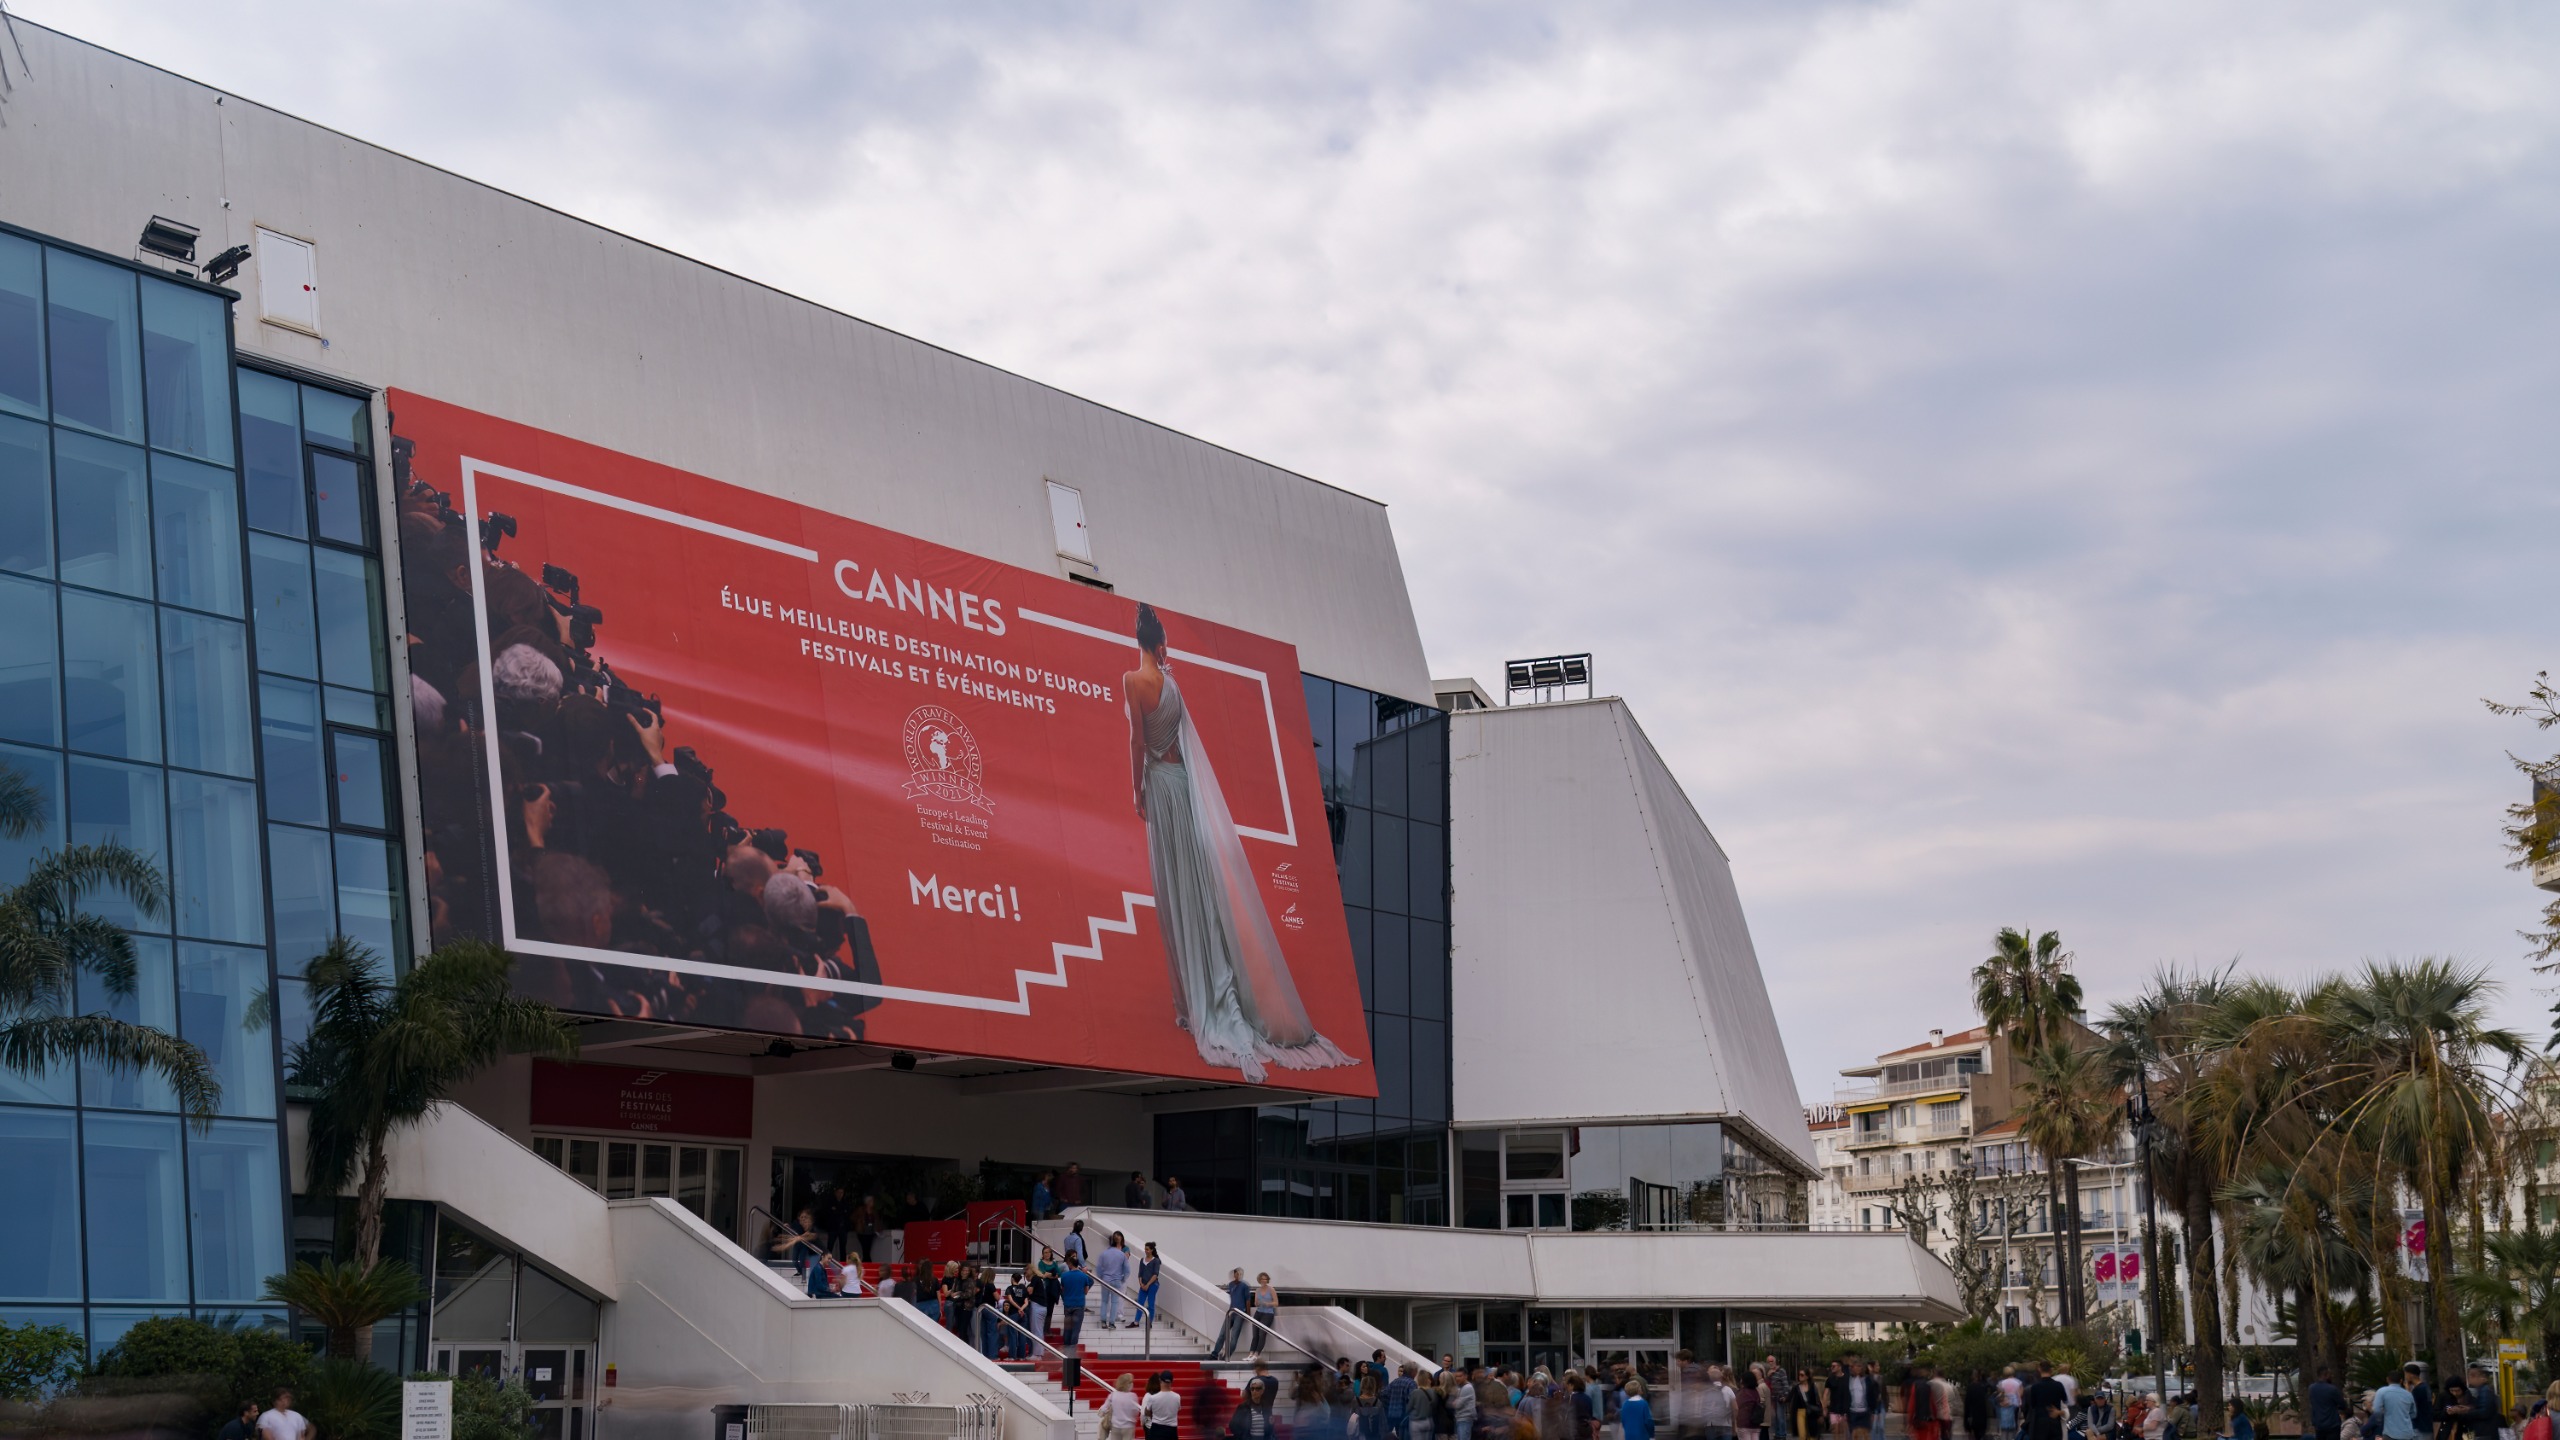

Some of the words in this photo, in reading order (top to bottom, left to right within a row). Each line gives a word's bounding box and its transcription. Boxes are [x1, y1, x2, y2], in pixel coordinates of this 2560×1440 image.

[833, 559, 1006, 636] CANNES
[721, 585, 773, 619] ÉLUE
[779, 604, 889, 648] MEILLEURE
[895, 634, 1021, 680] DESTINATION
[1025, 666, 1113, 702] D'EUROPE
[800, 638, 903, 679] FESTIVALS
[909, 665, 930, 685] ET
[936, 668, 1056, 715] ÉVÉNEMENTS
[905, 718, 919, 770] WORLD
[916, 708, 955, 726] TRAVEL
[956, 725, 980, 780] AWARDS
[920, 772, 975, 793] WINNER
[935, 785, 962, 800] 2021
[916, 804, 953, 820] Europe's
[955, 811, 989, 829] Leading
[920, 818, 953, 833] Festival
[954, 824, 963, 834] &
[965, 826, 988, 840] Event
[932, 833, 981, 851] Destination
[1281, 914, 1304, 925] CANNES
[620, 1089, 653, 1100] PALAIS
[655, 1092, 672, 1102] DES
[620, 1100, 672, 1113] FESTIVALS
[631, 1122, 658, 1131] CANNES
